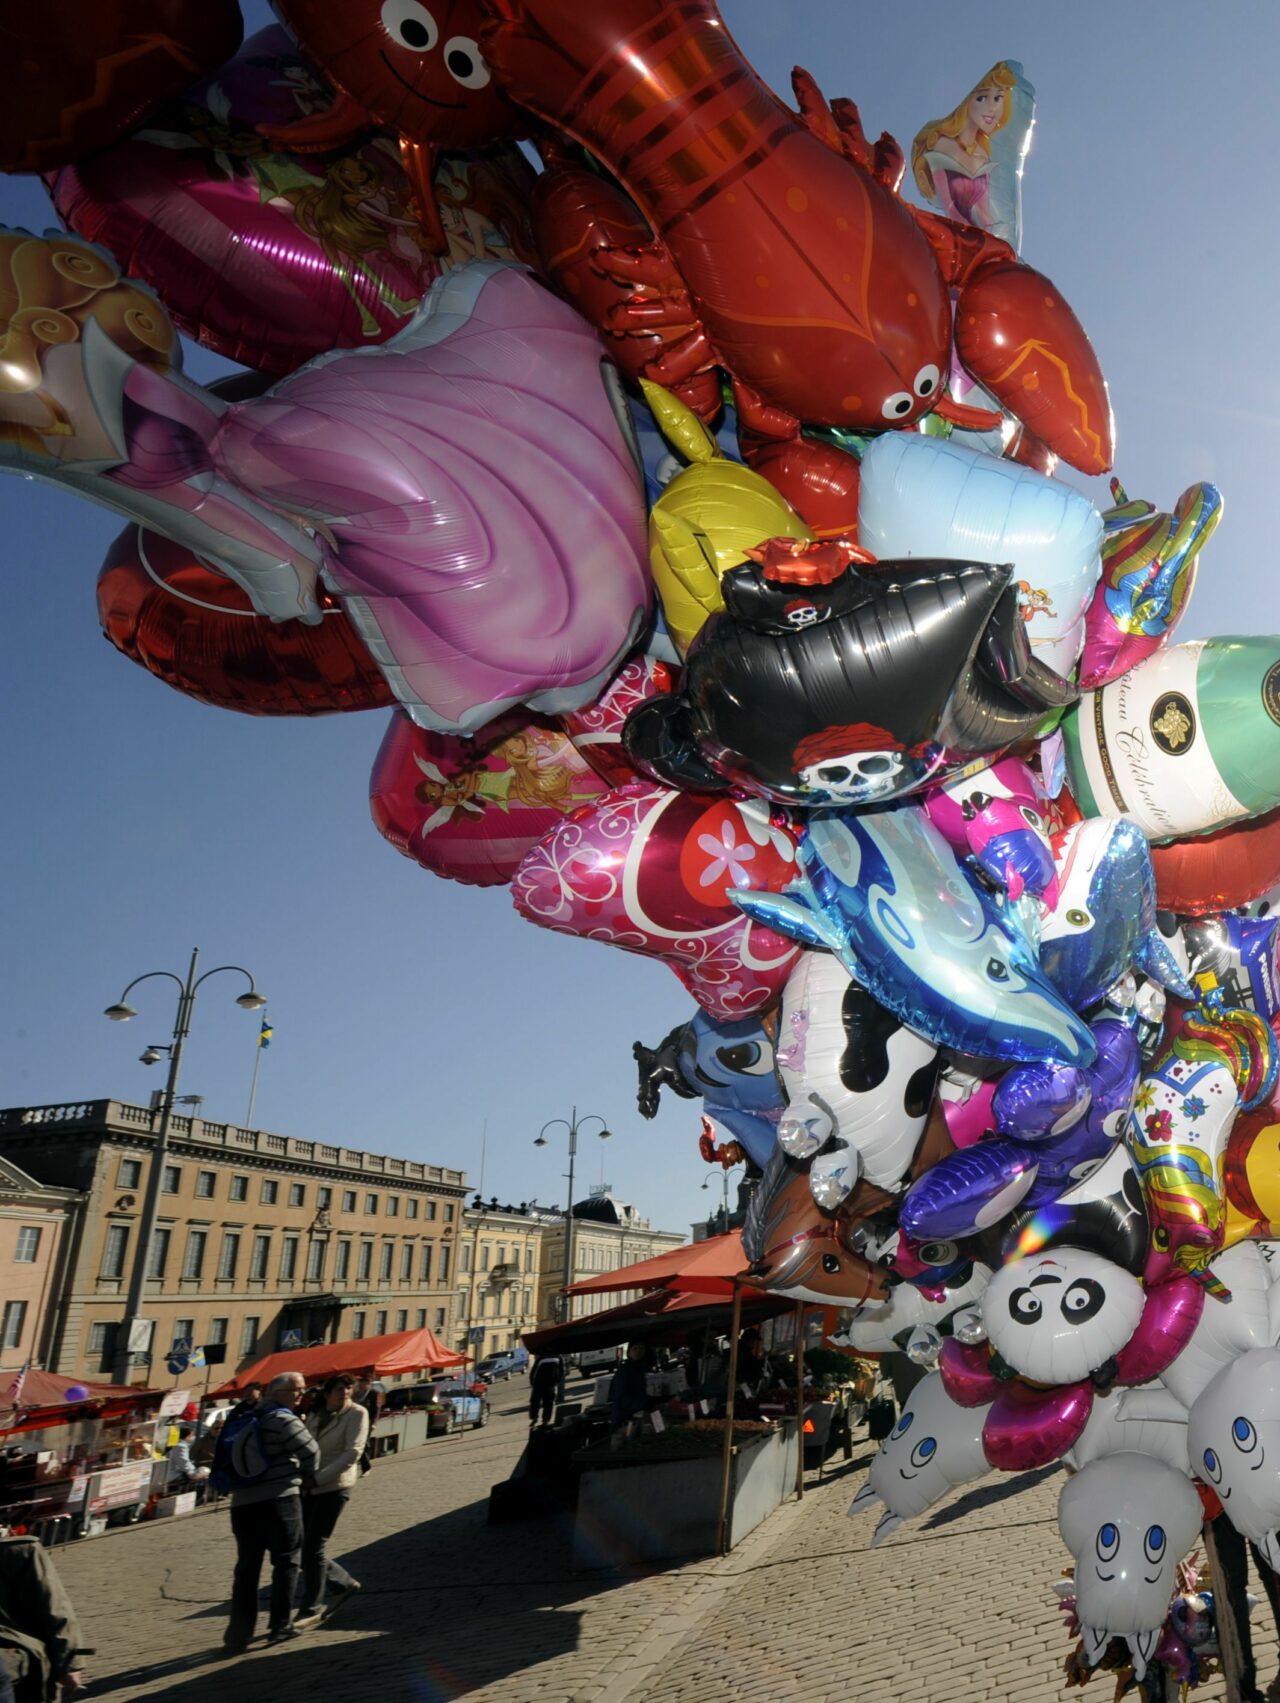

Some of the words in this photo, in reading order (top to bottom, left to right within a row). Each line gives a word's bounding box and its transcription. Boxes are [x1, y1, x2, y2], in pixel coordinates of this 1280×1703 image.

[1095, 705, 1105, 744] VINTAGE
[1100, 748, 1112, 777] GOOD
[1115, 726, 1177, 830] Célébration
